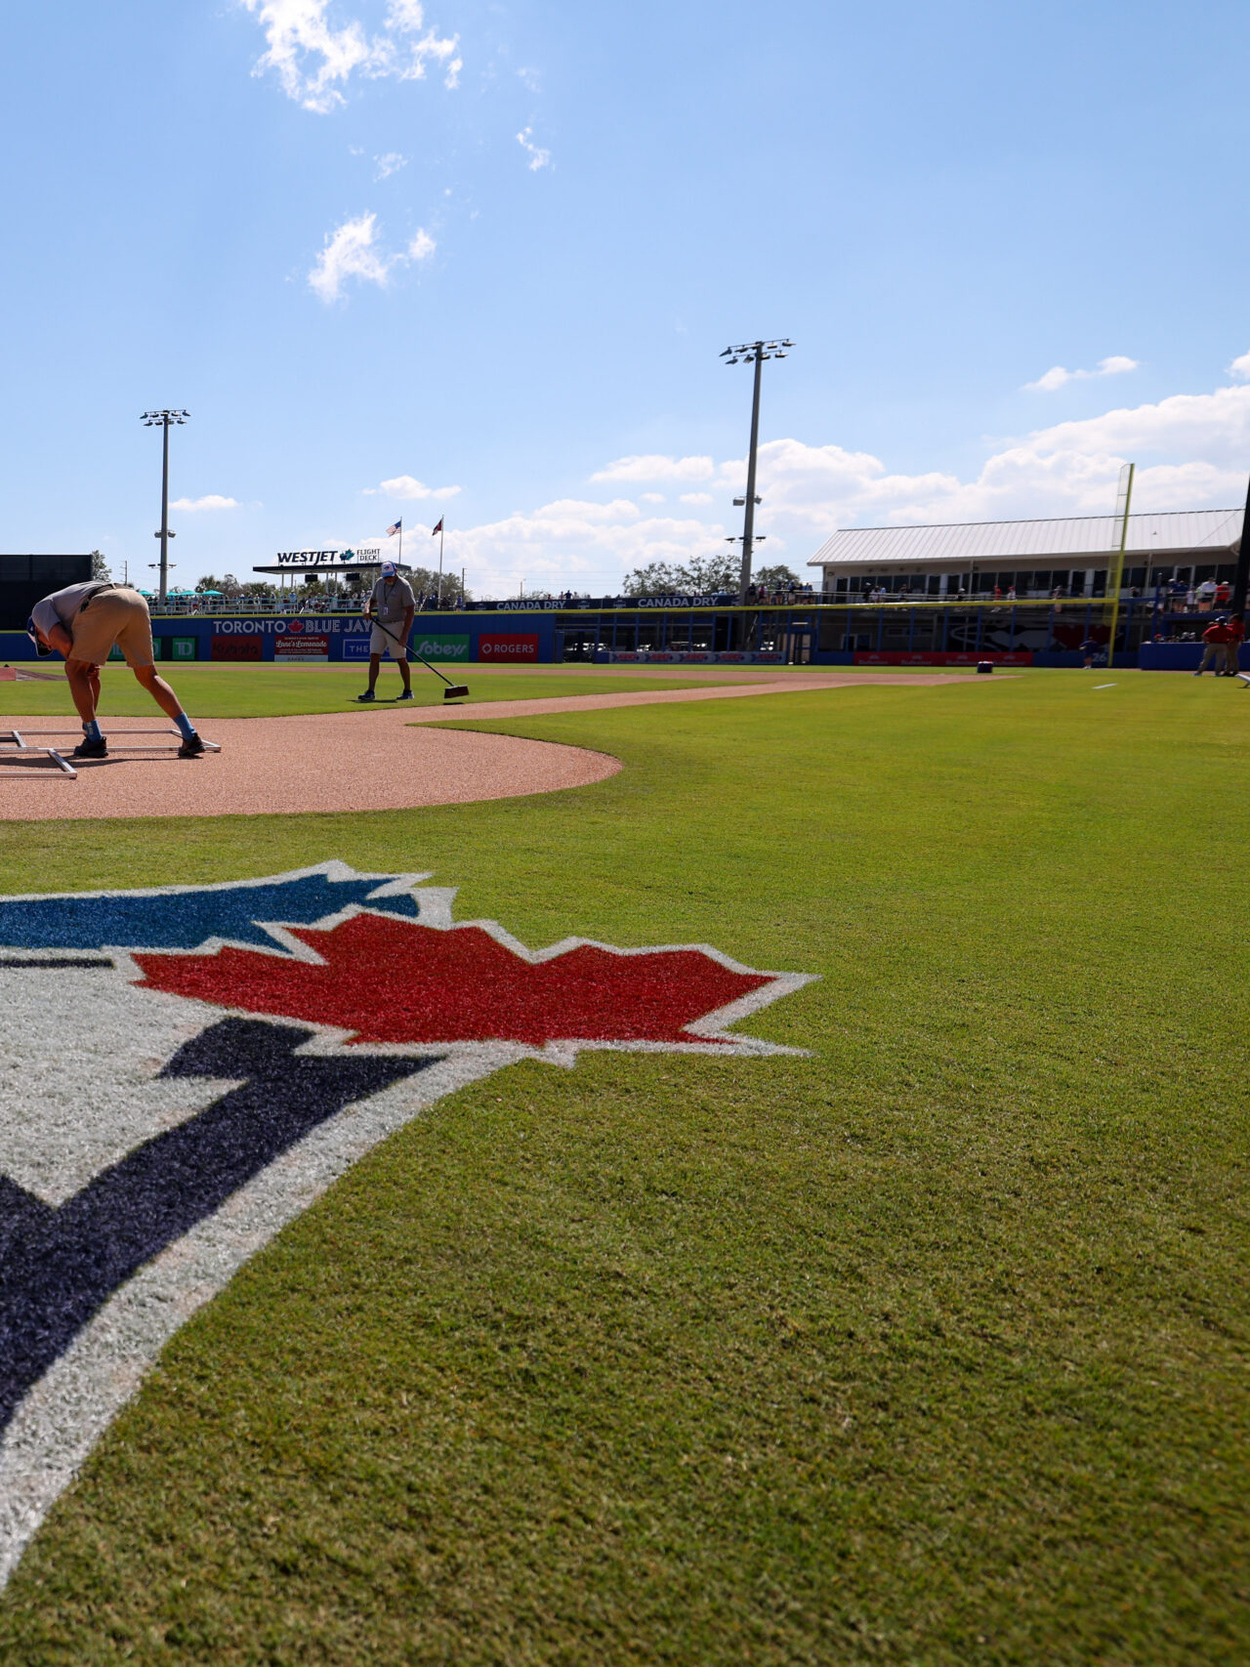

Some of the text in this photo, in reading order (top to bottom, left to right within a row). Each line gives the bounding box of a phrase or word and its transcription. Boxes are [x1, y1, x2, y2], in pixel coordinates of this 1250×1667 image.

[277, 551, 338, 565] WESTJET
[496, 600, 565, 610] CANADA DRY
[638, 597, 718, 608] CANADA DRY
[213, 619, 373, 634] TORONTO BLUE JAY
[175, 641, 193, 656] TD
[349, 645, 369, 653] THE
[494, 644, 534, 653] ROGERS
